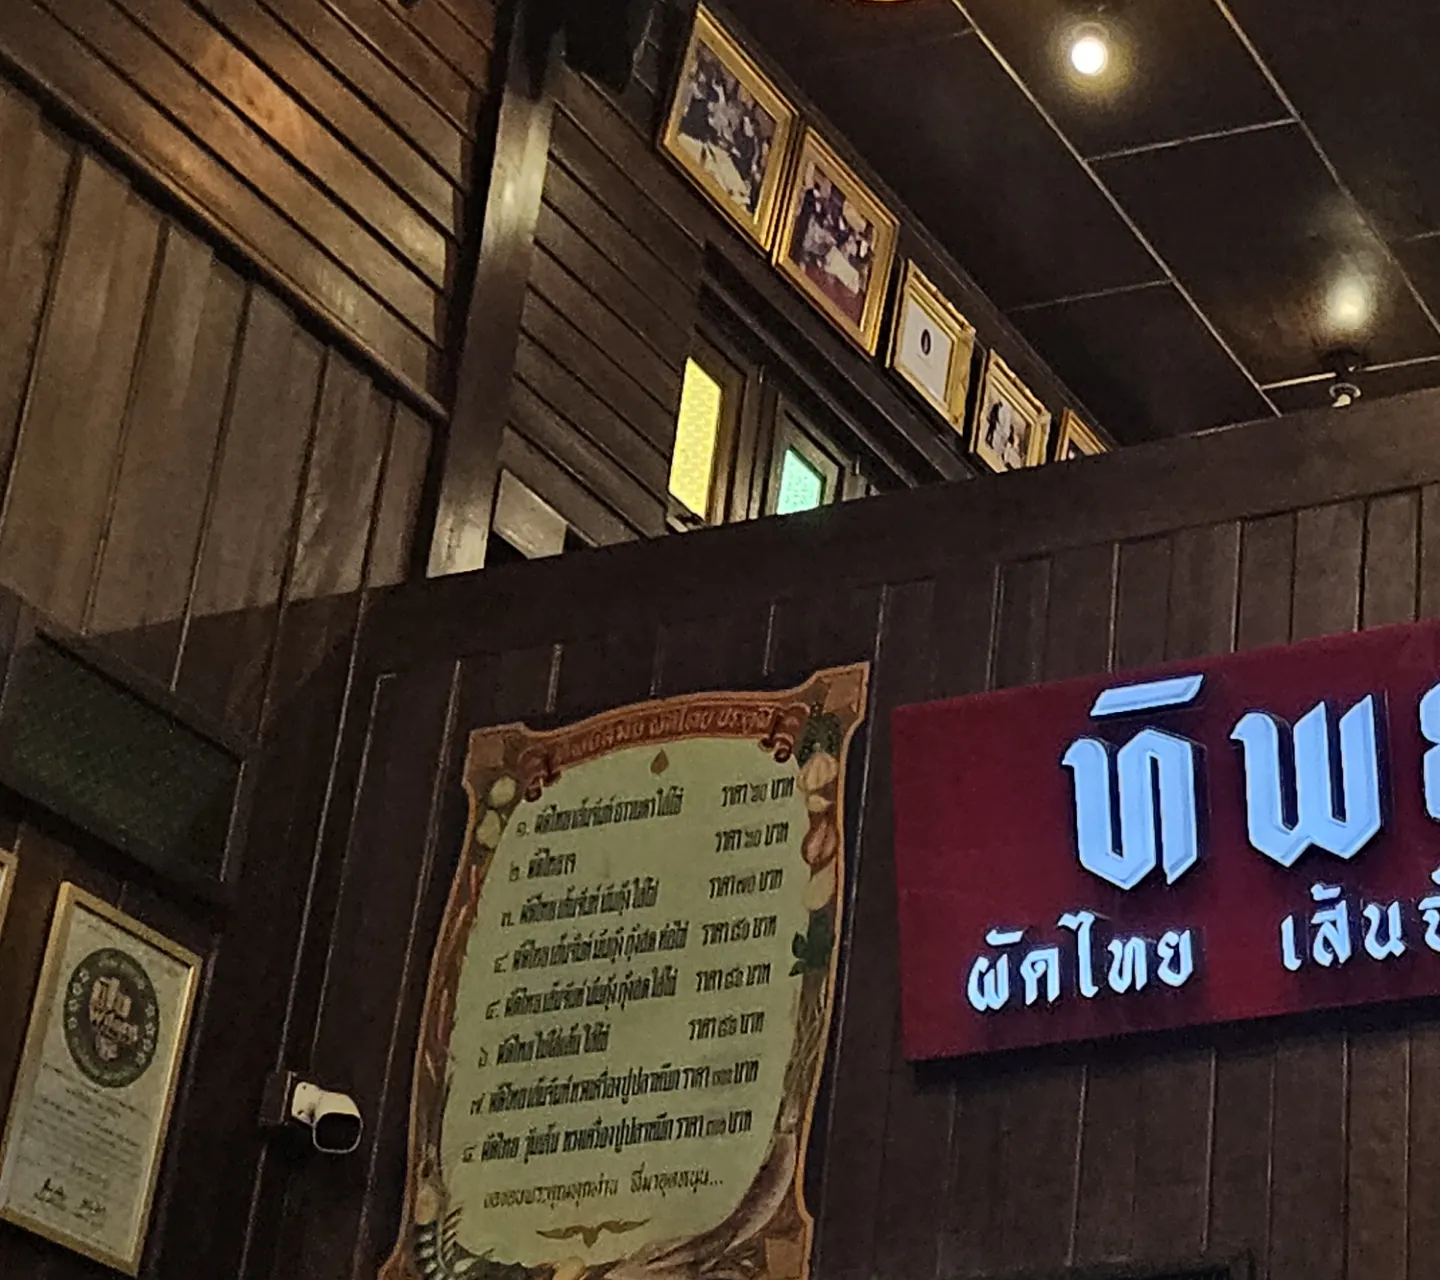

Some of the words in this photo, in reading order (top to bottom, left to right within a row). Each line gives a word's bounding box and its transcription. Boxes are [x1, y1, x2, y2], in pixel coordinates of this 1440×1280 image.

[721, 783, 747, 808] ราคา
[771, 776, 795, 801] บาท
[715, 830, 742, 853] ราคา
[764, 821, 789, 847] บาท
[709, 876, 736, 900] ราคา
[759, 868, 783, 893] บาท
[702, 922, 730, 947] ราคา
[752, 914, 777, 938] บาท
[966, 911, 1195, 1012] ผัดไทย
[695, 969, 723, 993] ราคา
[746, 963, 771, 986] บาท
[688, 1018, 717, 1041] ราคา
[739, 1011, 765, 1034] บาท
[681, 1065, 708, 1090] ราคา
[733, 1060, 759, 1084] บาท
[675, 1114, 704, 1139] ราคา
[728, 1109, 752, 1134] บาท
